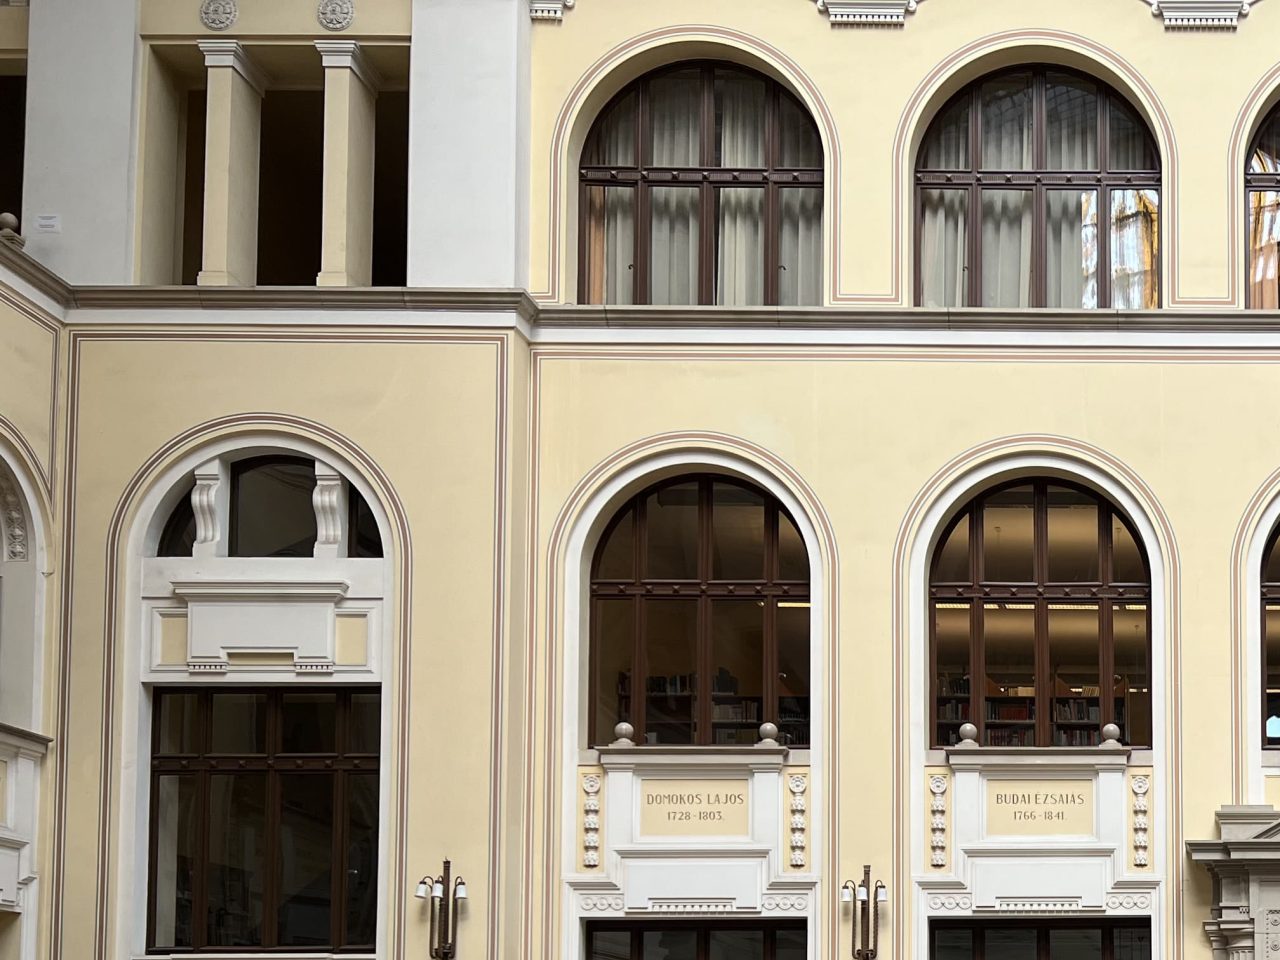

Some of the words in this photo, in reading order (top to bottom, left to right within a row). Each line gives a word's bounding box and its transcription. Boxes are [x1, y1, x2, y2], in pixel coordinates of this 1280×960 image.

[646, 793, 703, 805] DOMOKOS
[706, 793, 745, 805] LAJOS
[996, 793, 1031, 805] BUDAI
